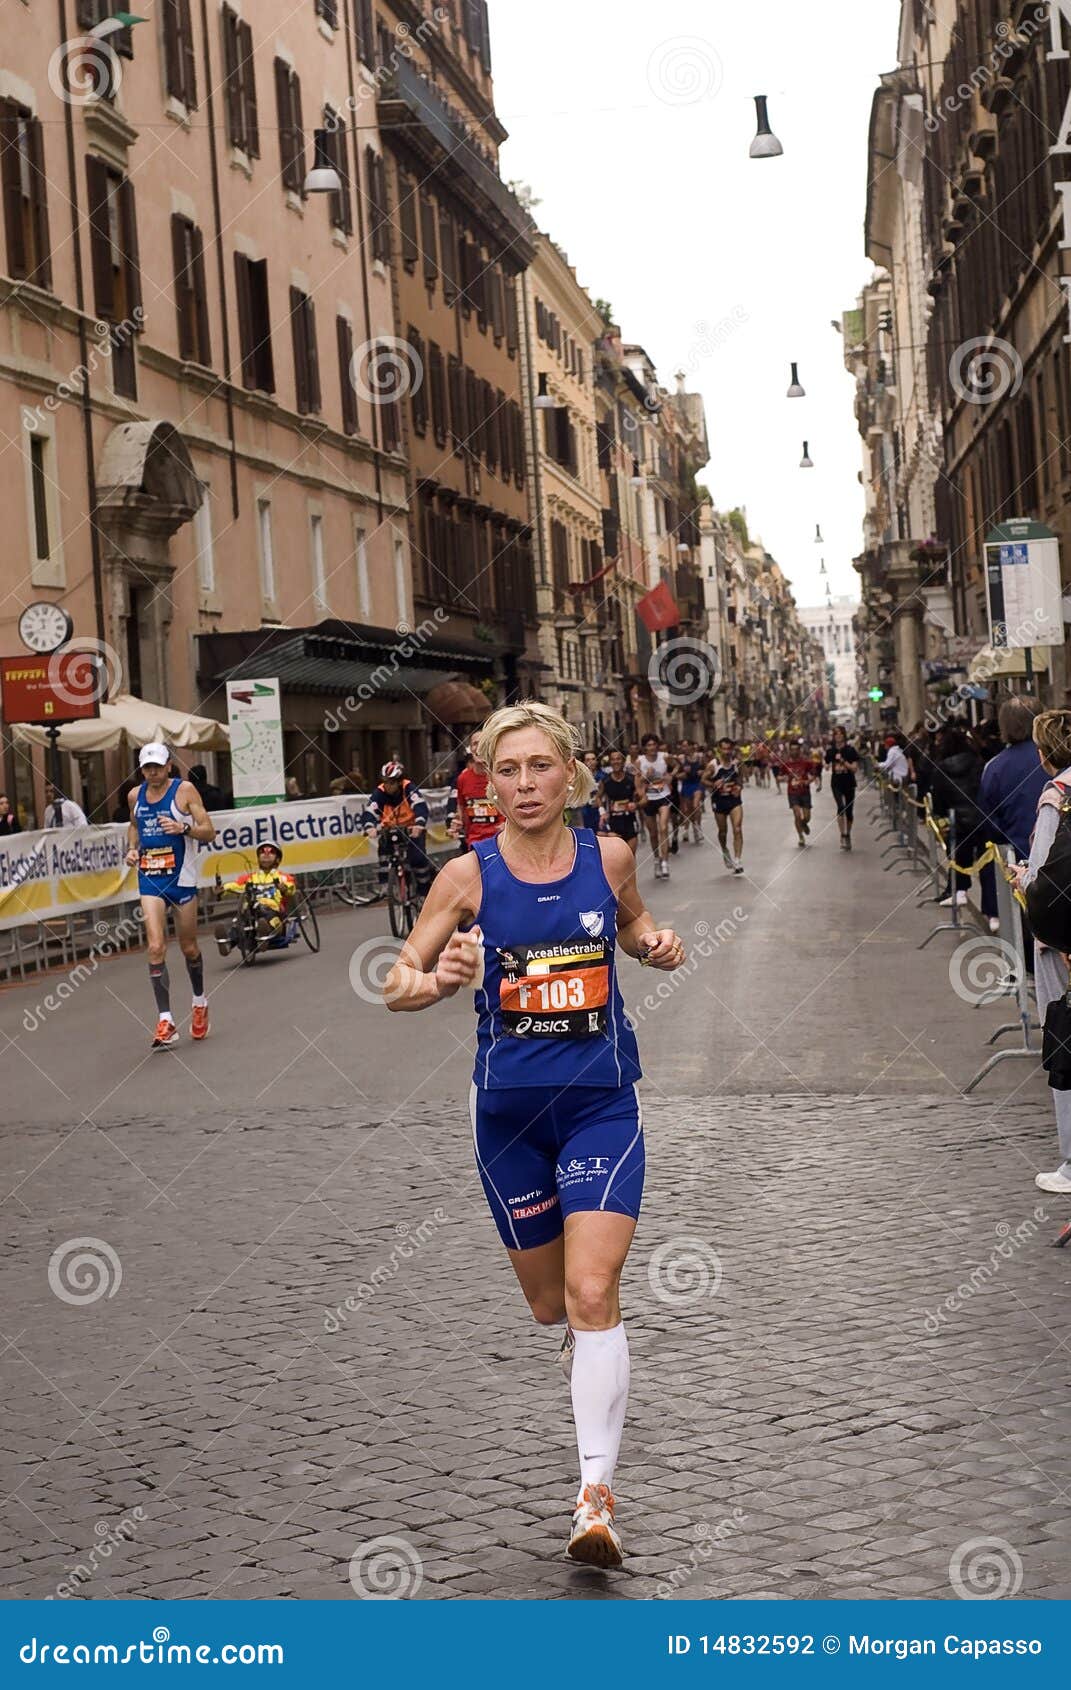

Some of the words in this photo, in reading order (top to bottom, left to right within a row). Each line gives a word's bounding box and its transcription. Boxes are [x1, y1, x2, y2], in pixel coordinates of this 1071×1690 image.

[197, 804, 366, 854] ceaElectrabe
[526, 940, 605, 961] AceaElectrabel
[519, 984, 532, 1009] F
[537, 977, 586, 1010] 103
[532, 1019, 570, 1033] asics
[567, 1159, 587, 1171] &
[588, 1157, 610, 1169] T
[508, 1190, 536, 1205] CRAFT
[514, 1205, 540, 1218] TEAM
